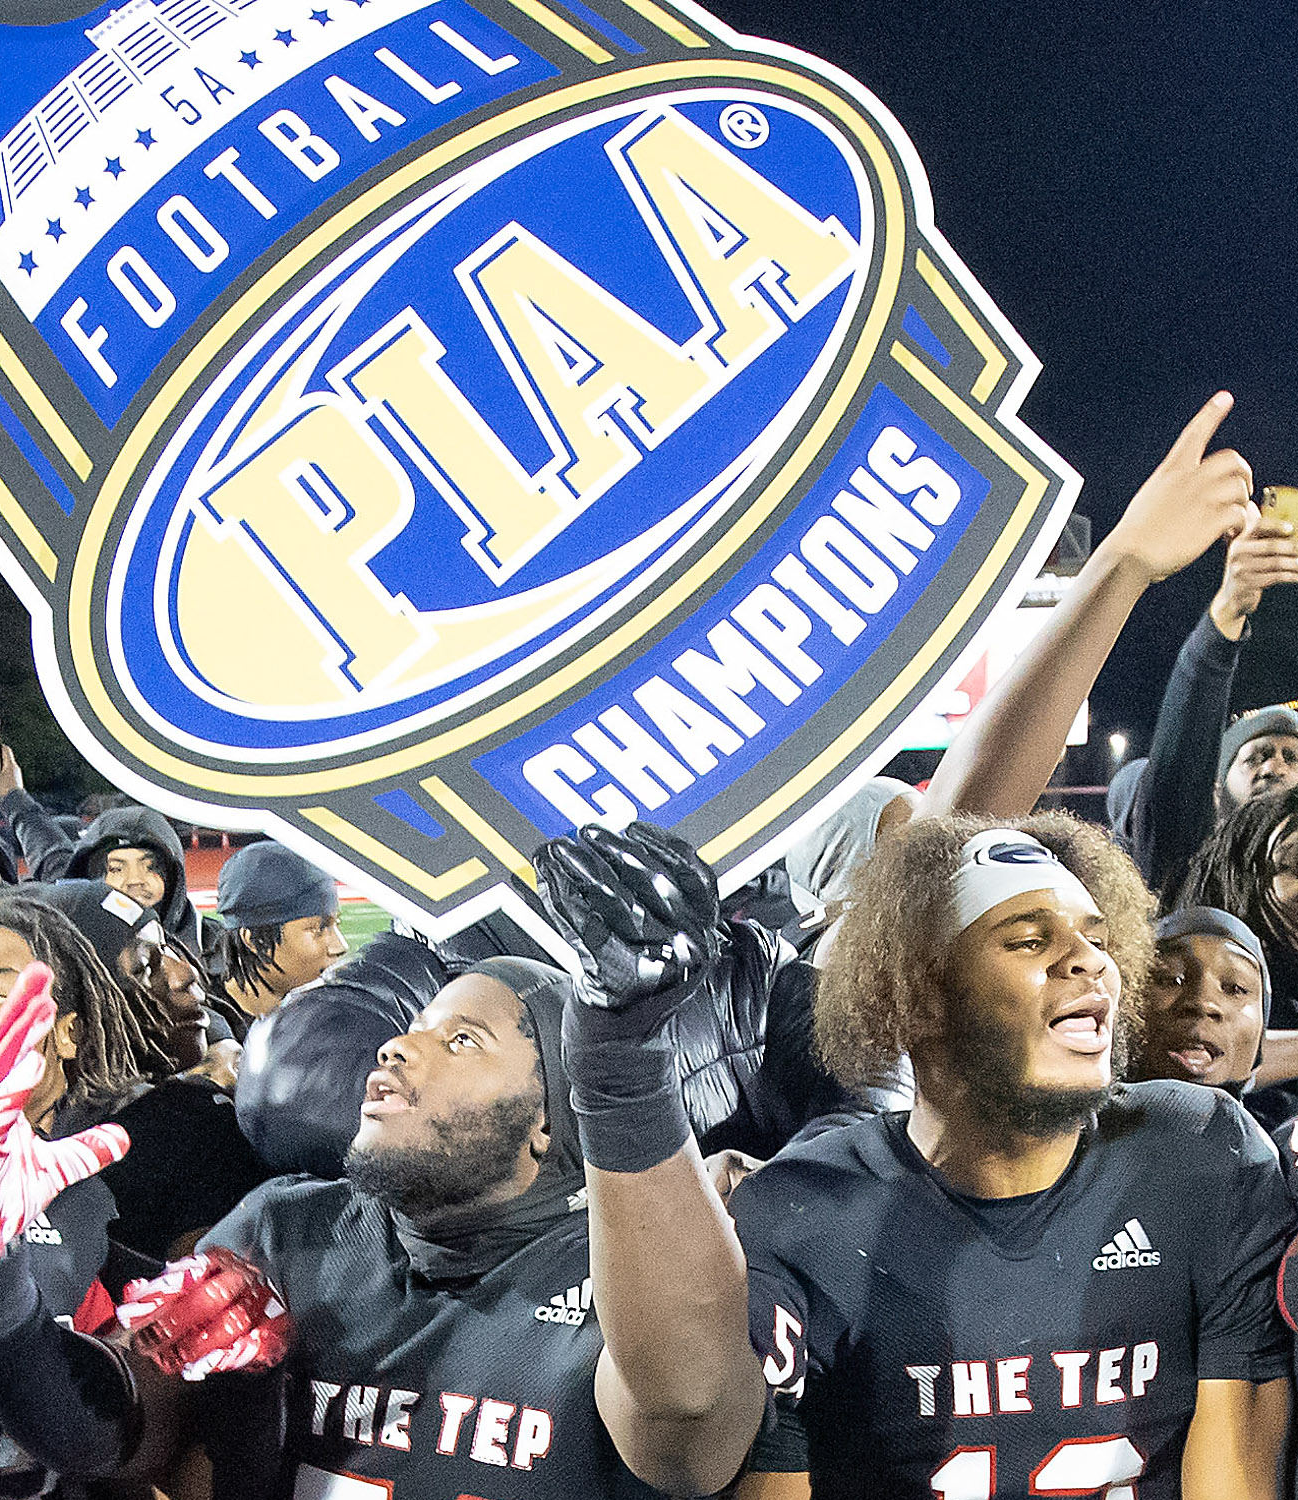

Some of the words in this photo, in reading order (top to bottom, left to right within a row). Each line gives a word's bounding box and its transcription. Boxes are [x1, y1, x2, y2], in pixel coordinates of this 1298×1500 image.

[161, 64, 236, 127] 5A
[60, 19, 519, 388] FOOTBALL
[192, 104, 862, 693] PIAA
[522, 424, 963, 830] CHAMPIONS
[1093, 1249, 1161, 1271] adidas
[311, 1379, 420, 1452] THE
[435, 1391, 553, 1471] TEP
[907, 1355, 1034, 1417] THE
[1051, 1341, 1160, 1410] TEP
